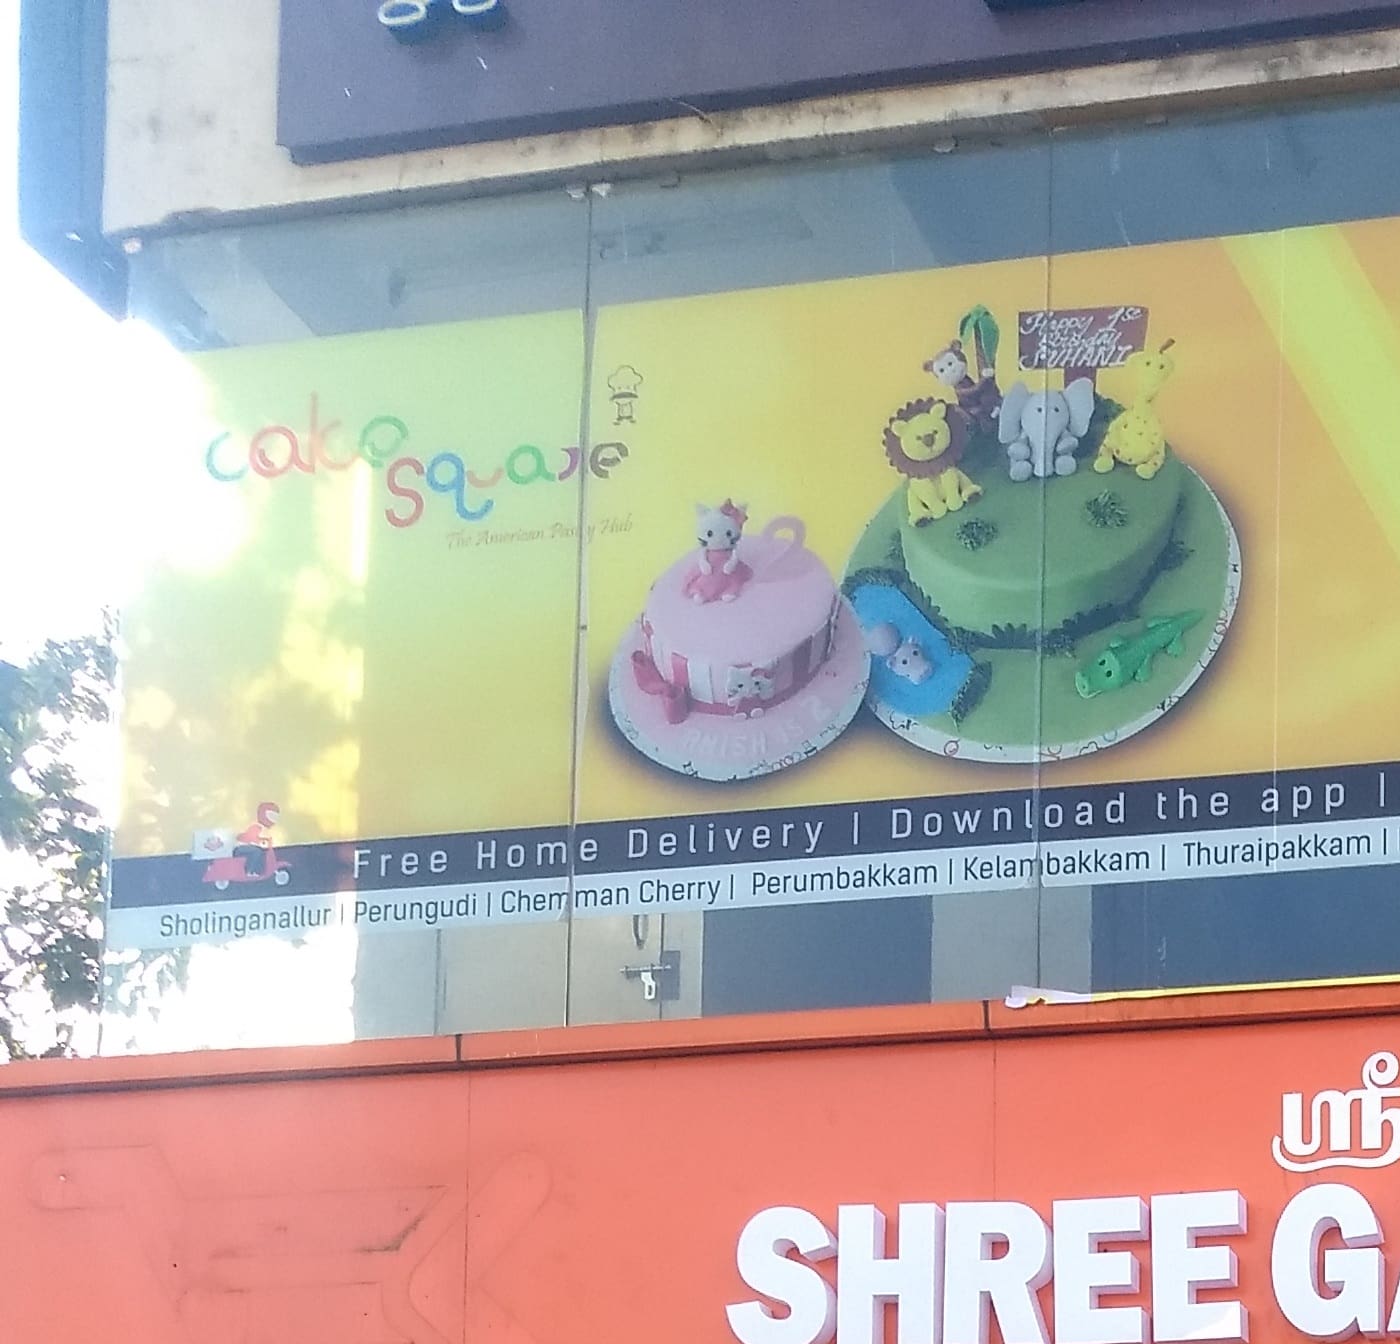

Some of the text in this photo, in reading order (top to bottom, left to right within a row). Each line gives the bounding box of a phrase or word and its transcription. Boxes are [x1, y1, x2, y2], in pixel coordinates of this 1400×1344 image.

[205, 392, 410, 482] cake
[384, 441, 630, 528] square
[549, 520, 596, 543] Pasy
[353, 846, 448, 880] Free
[477, 836, 598, 870] Home
[628, 818, 823, 858] Delivery
[891, 792, 1126, 839] Download
[1157, 785, 1230, 820] the
[1261, 780, 1345, 818] app
[159, 904, 332, 938] Sholinganallur
[354, 891, 477, 927] Perungudi
[639, 877, 720, 904] Cherry
[751, 855, 938, 896] Perumbakkam
[962, 847, 1150, 881] Kelambakkam
[1183, 830, 1371, 868] Thuraipakkam
